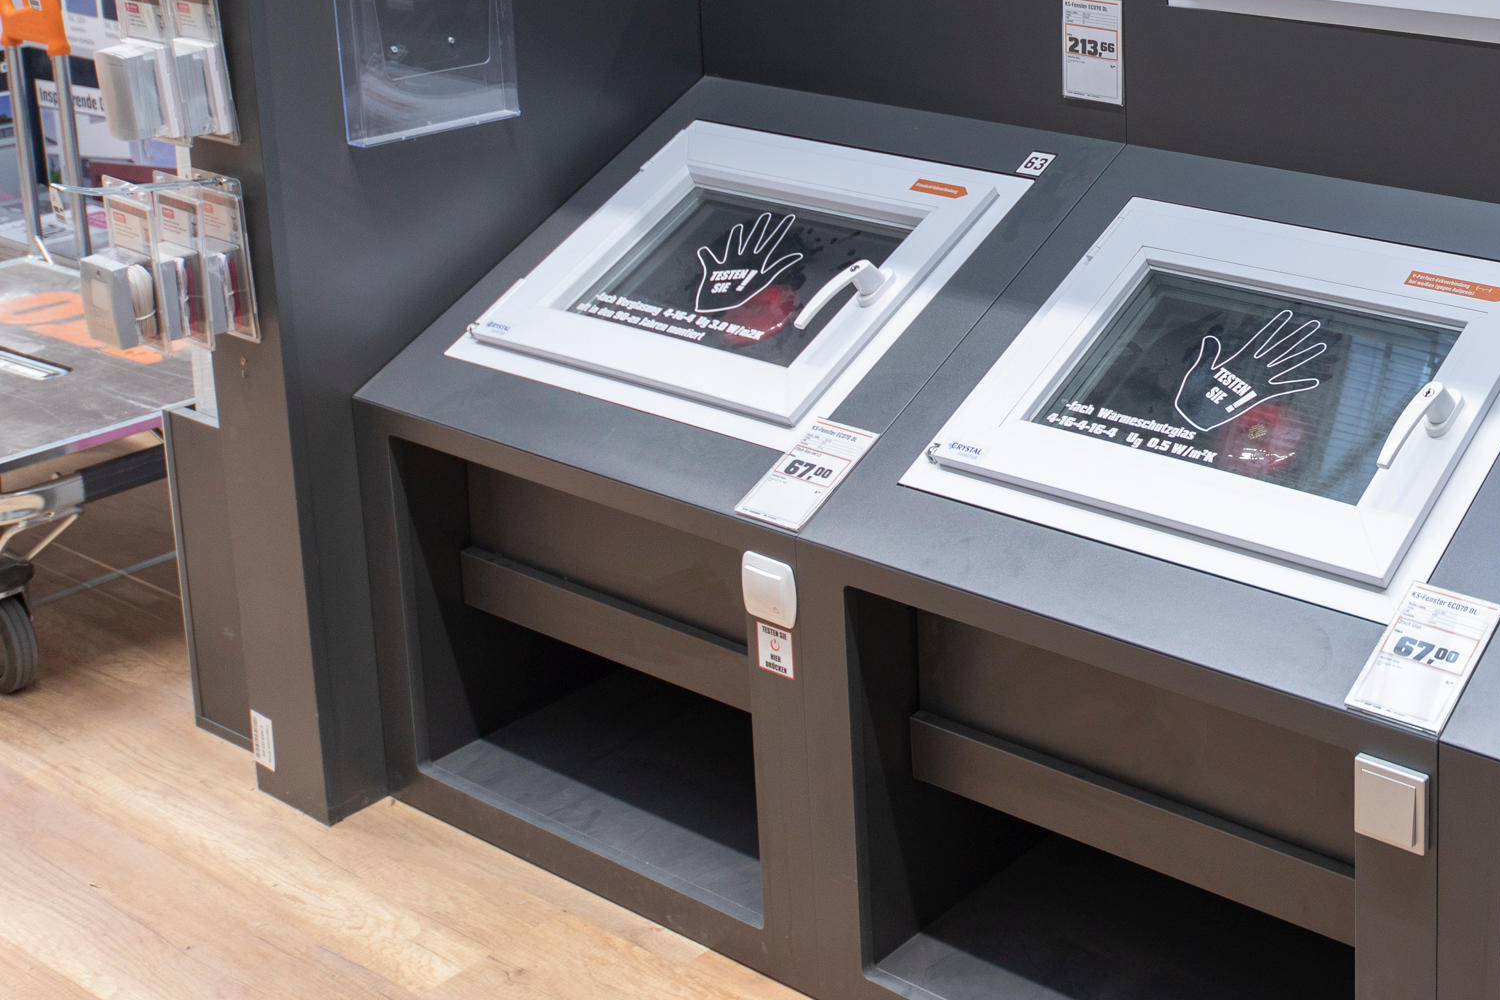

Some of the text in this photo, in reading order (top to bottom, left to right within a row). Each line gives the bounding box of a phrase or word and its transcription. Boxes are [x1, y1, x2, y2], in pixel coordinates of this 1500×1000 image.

[1068, 36, 1115, 57] 213,66
[1023, 156, 1049, 171] 63
[709, 269, 750, 282] TESTEN
[710, 282, 732, 294] SIE
[615, 295, 663, 316] Verglasung
[597, 306, 615, 318] den
[638, 317, 669, 332] Jahren
[665, 324, 706, 341] montiert
[1212, 367, 1252, 398] TESTEN
[1205, 386, 1229, 405] SIE
[1065, 400, 1095, 416] -fach
[1046, 412, 1119, 438] 4-16-4-16-4
[1125, 431, 1144, 449] Ug
[1146, 436, 1173, 452] 0,5
[950, 441, 983, 456] CRYSTAL
[783, 459, 833, 480] 67,00
[1411, 591, 1448, 607] KS-Fenster
[1393, 636, 1461, 665] 67,00
